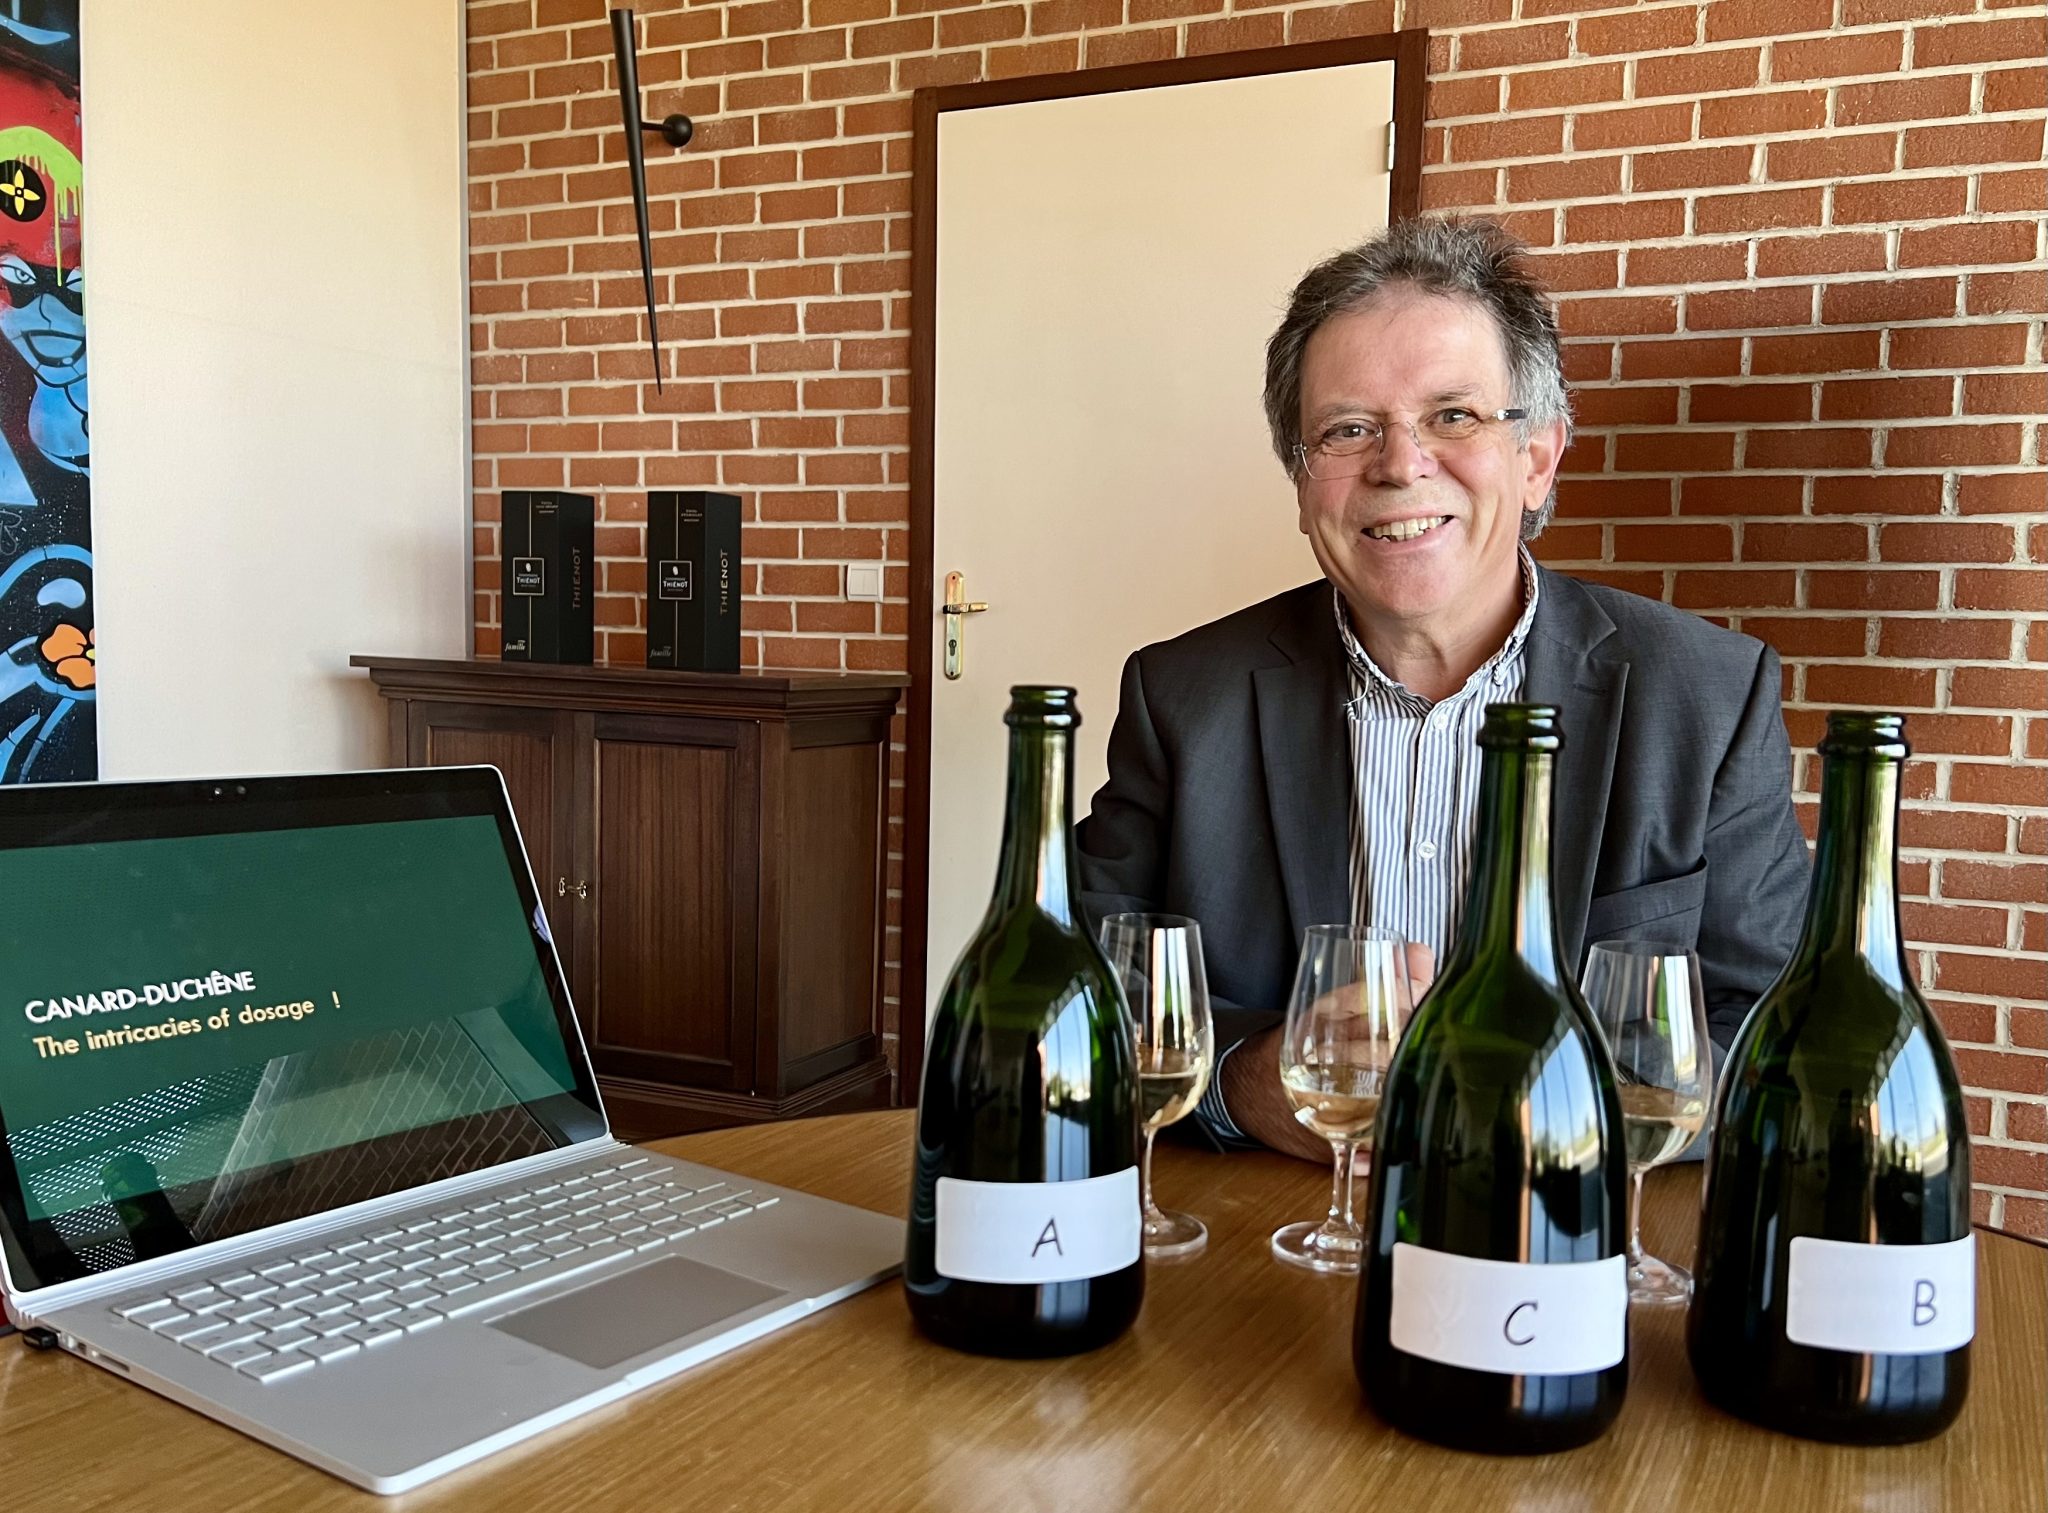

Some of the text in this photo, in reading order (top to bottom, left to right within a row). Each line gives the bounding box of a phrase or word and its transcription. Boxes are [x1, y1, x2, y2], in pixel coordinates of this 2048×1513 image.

[24, 970, 256, 1024] CANARD-DUCHÊNE
[32, 1036, 80, 1058] The
[85, 1018, 202, 1051] intricacies
[207, 1007, 230, 1030] of
[238, 1000, 315, 1025] dosage
[1031, 1218, 1063, 1258] A
[1503, 1301, 1538, 1346] C
[1913, 1279, 1937, 1326] B
